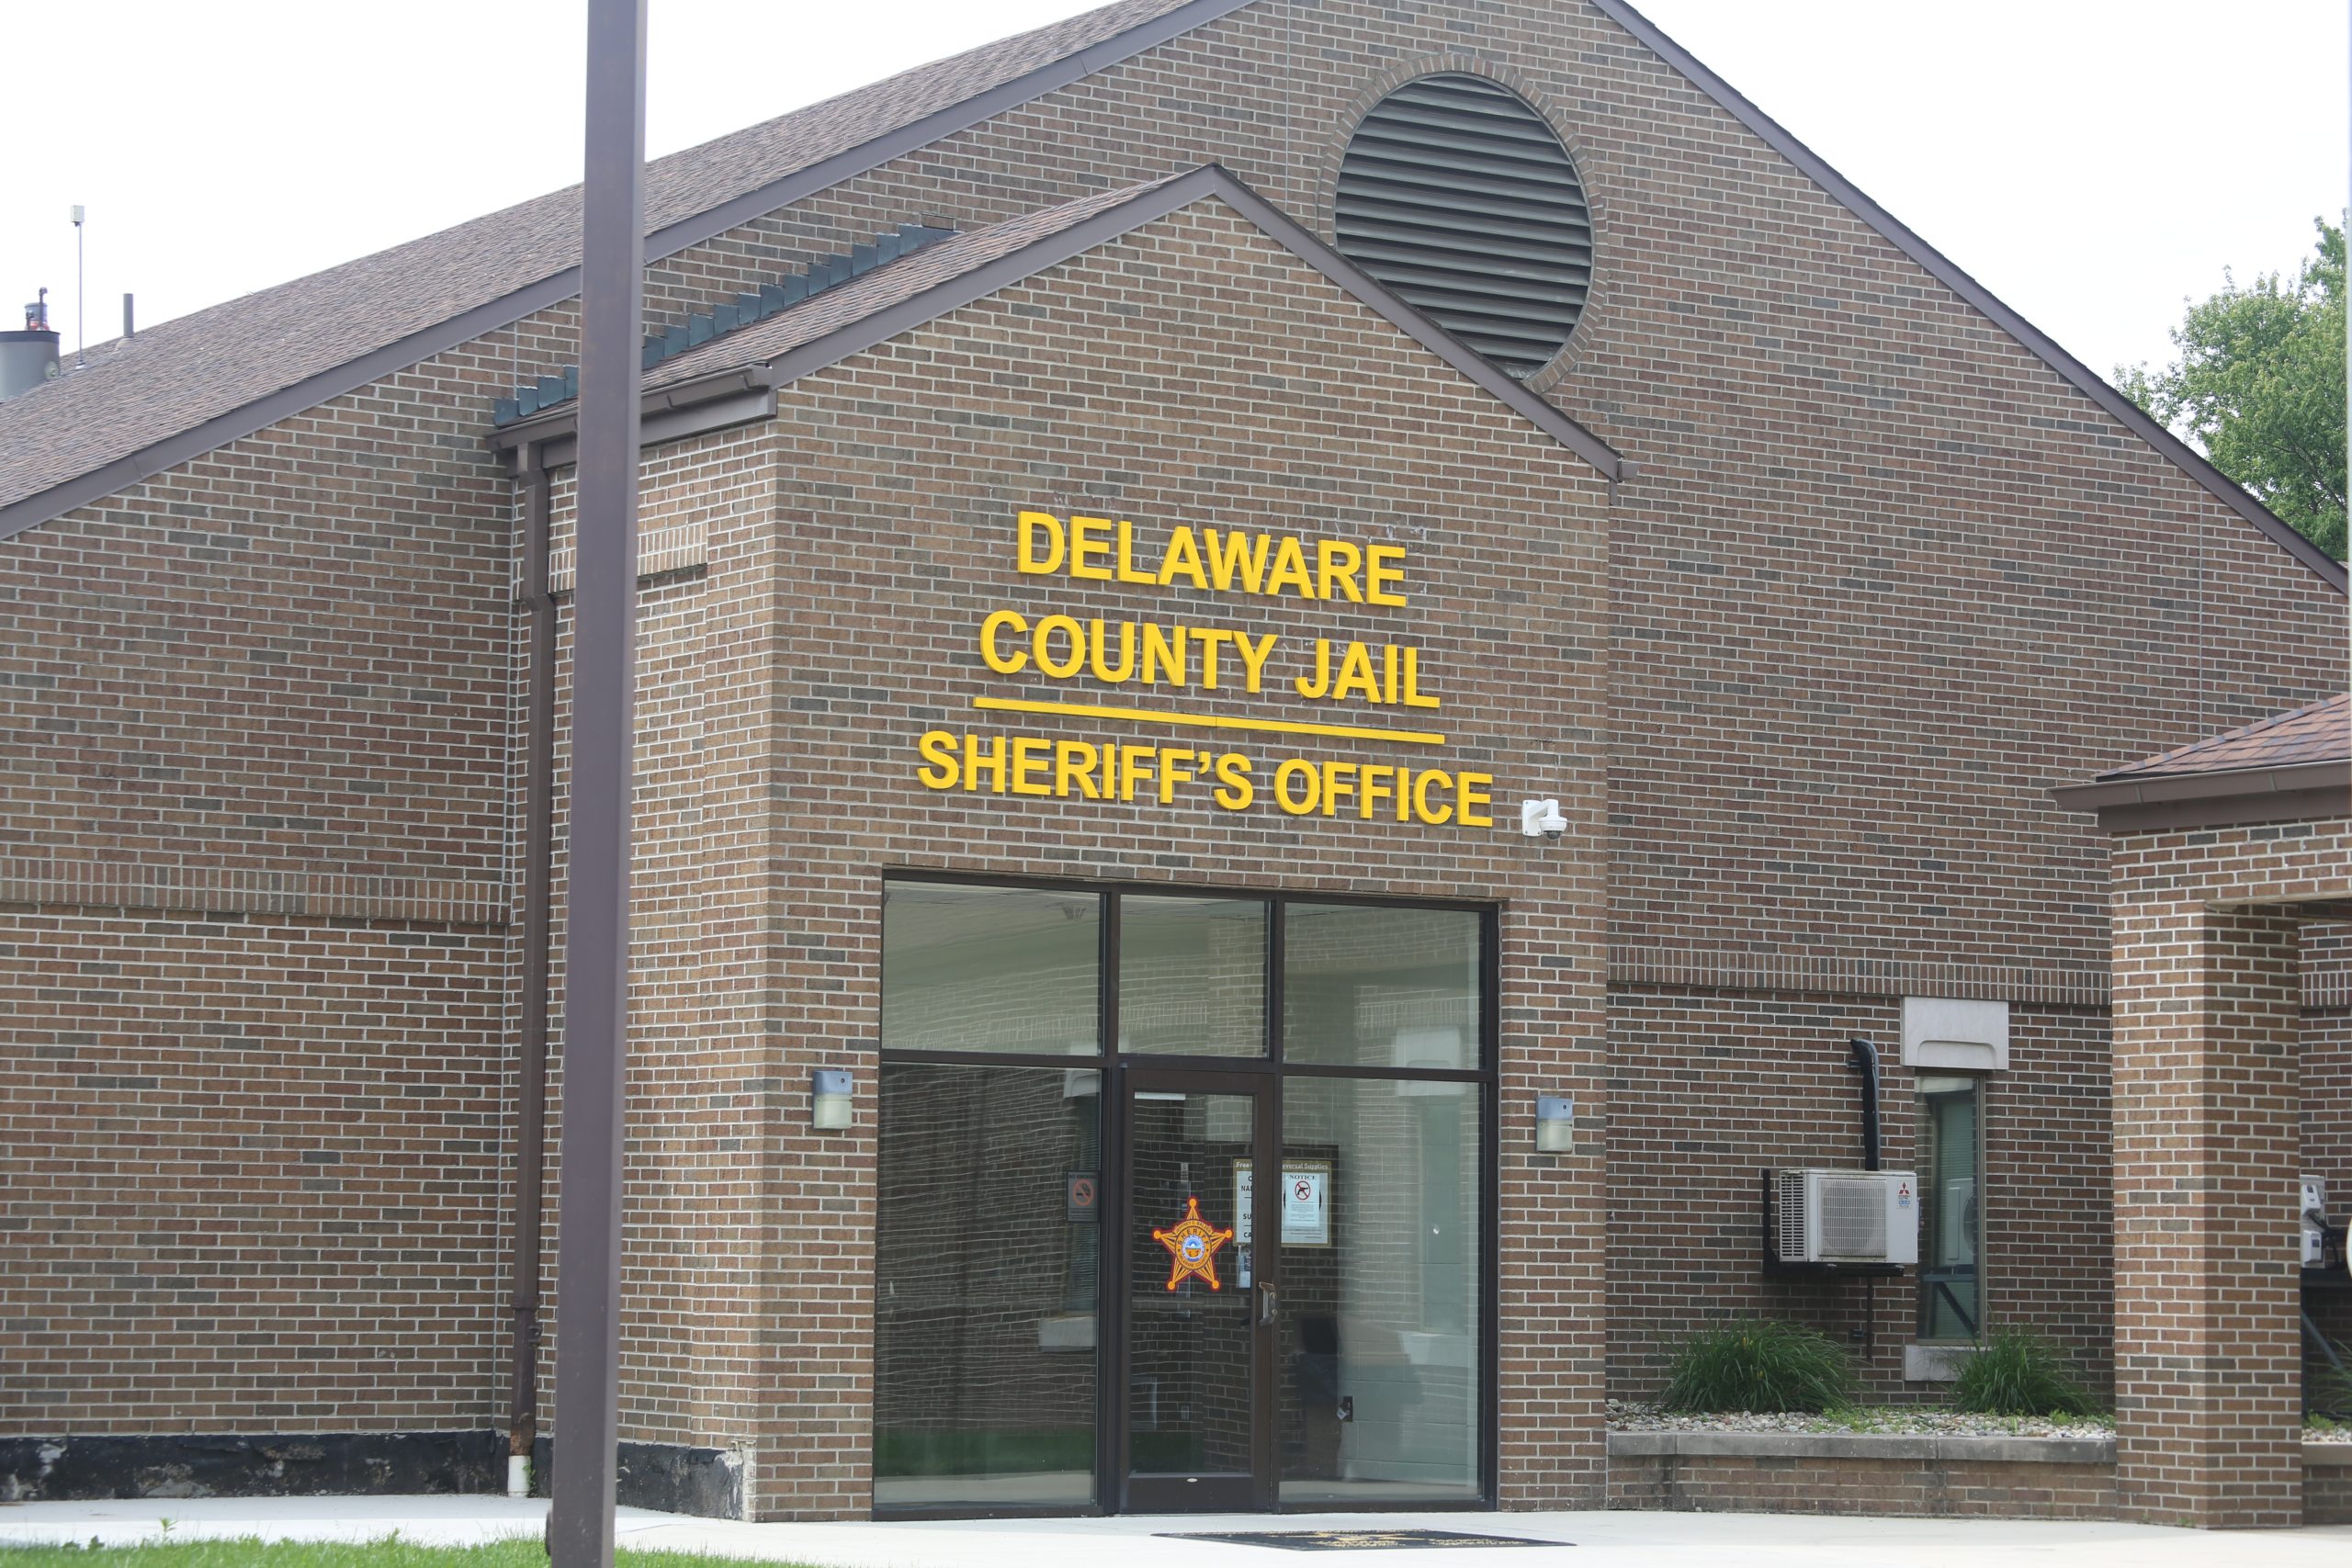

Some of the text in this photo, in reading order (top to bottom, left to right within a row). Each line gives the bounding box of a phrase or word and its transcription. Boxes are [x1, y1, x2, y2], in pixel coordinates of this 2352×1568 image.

[1016, 510, 1408, 607] DELAWARE
[978, 610, 1442, 707] COUNTY JAIL
[916, 730, 1495, 827] SHERIFF'S OFFICE
[1178, 1228, 1210, 1245] SHERIFF
